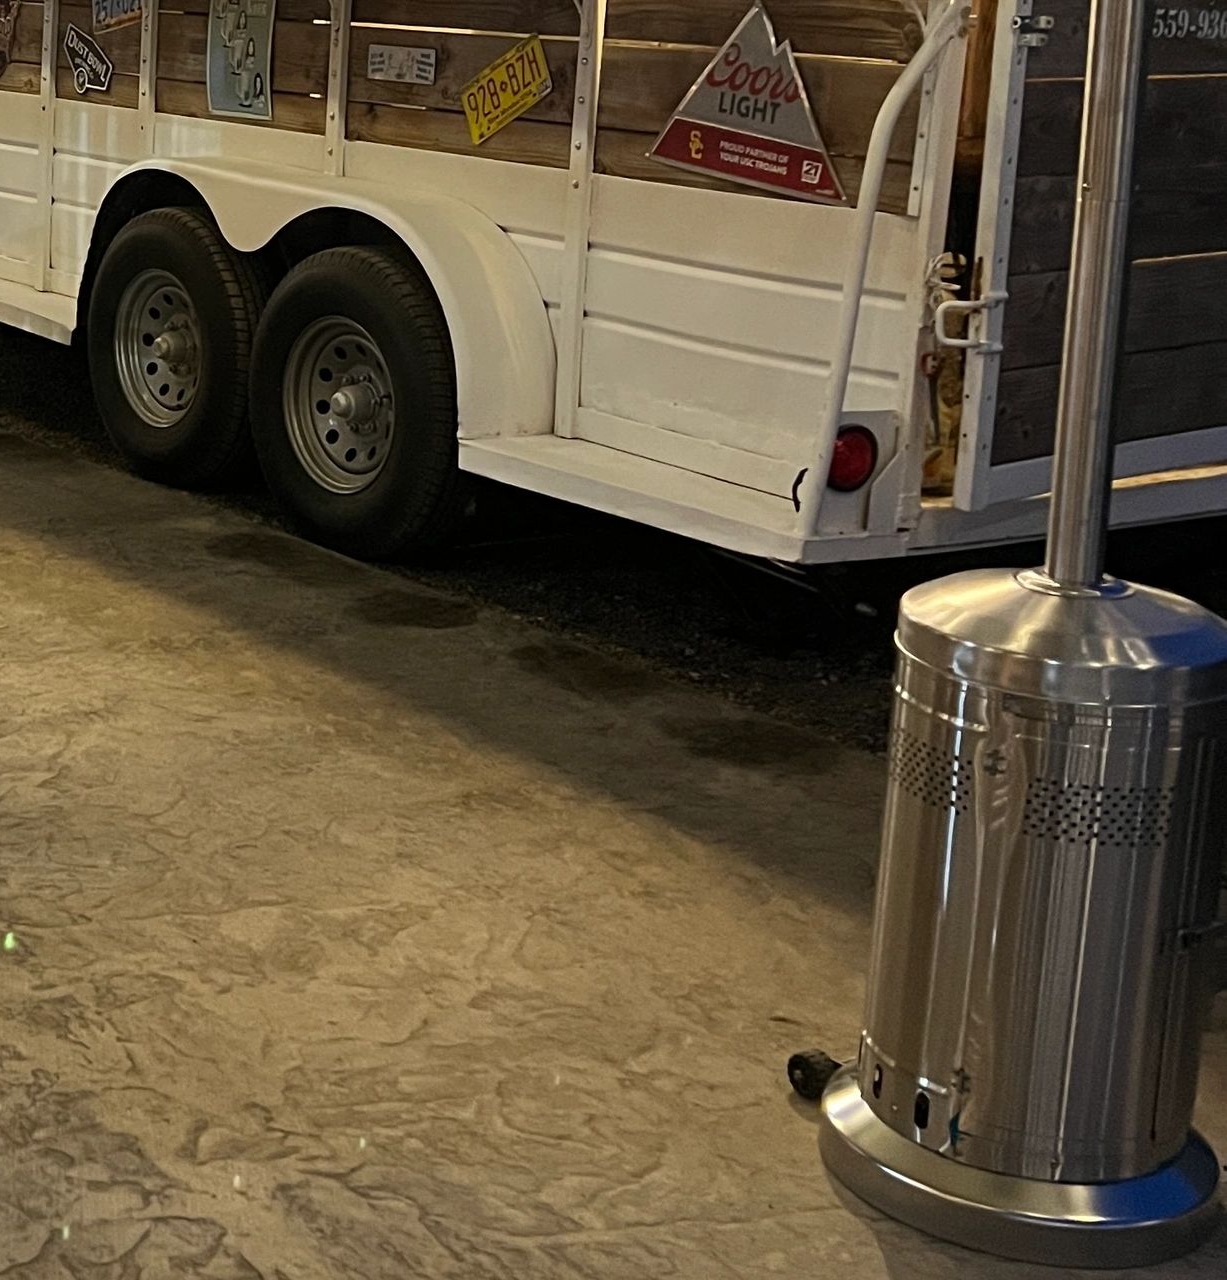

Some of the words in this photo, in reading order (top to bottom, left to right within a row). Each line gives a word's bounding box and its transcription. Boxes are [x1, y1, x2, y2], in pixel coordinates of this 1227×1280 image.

[68, 30, 90, 59] DUST
[706, 42, 802, 104] Coors
[718, 91, 781, 125] LIGHT
[719, 140, 745, 154] PROUD
[803, 162, 820, 177] 21
